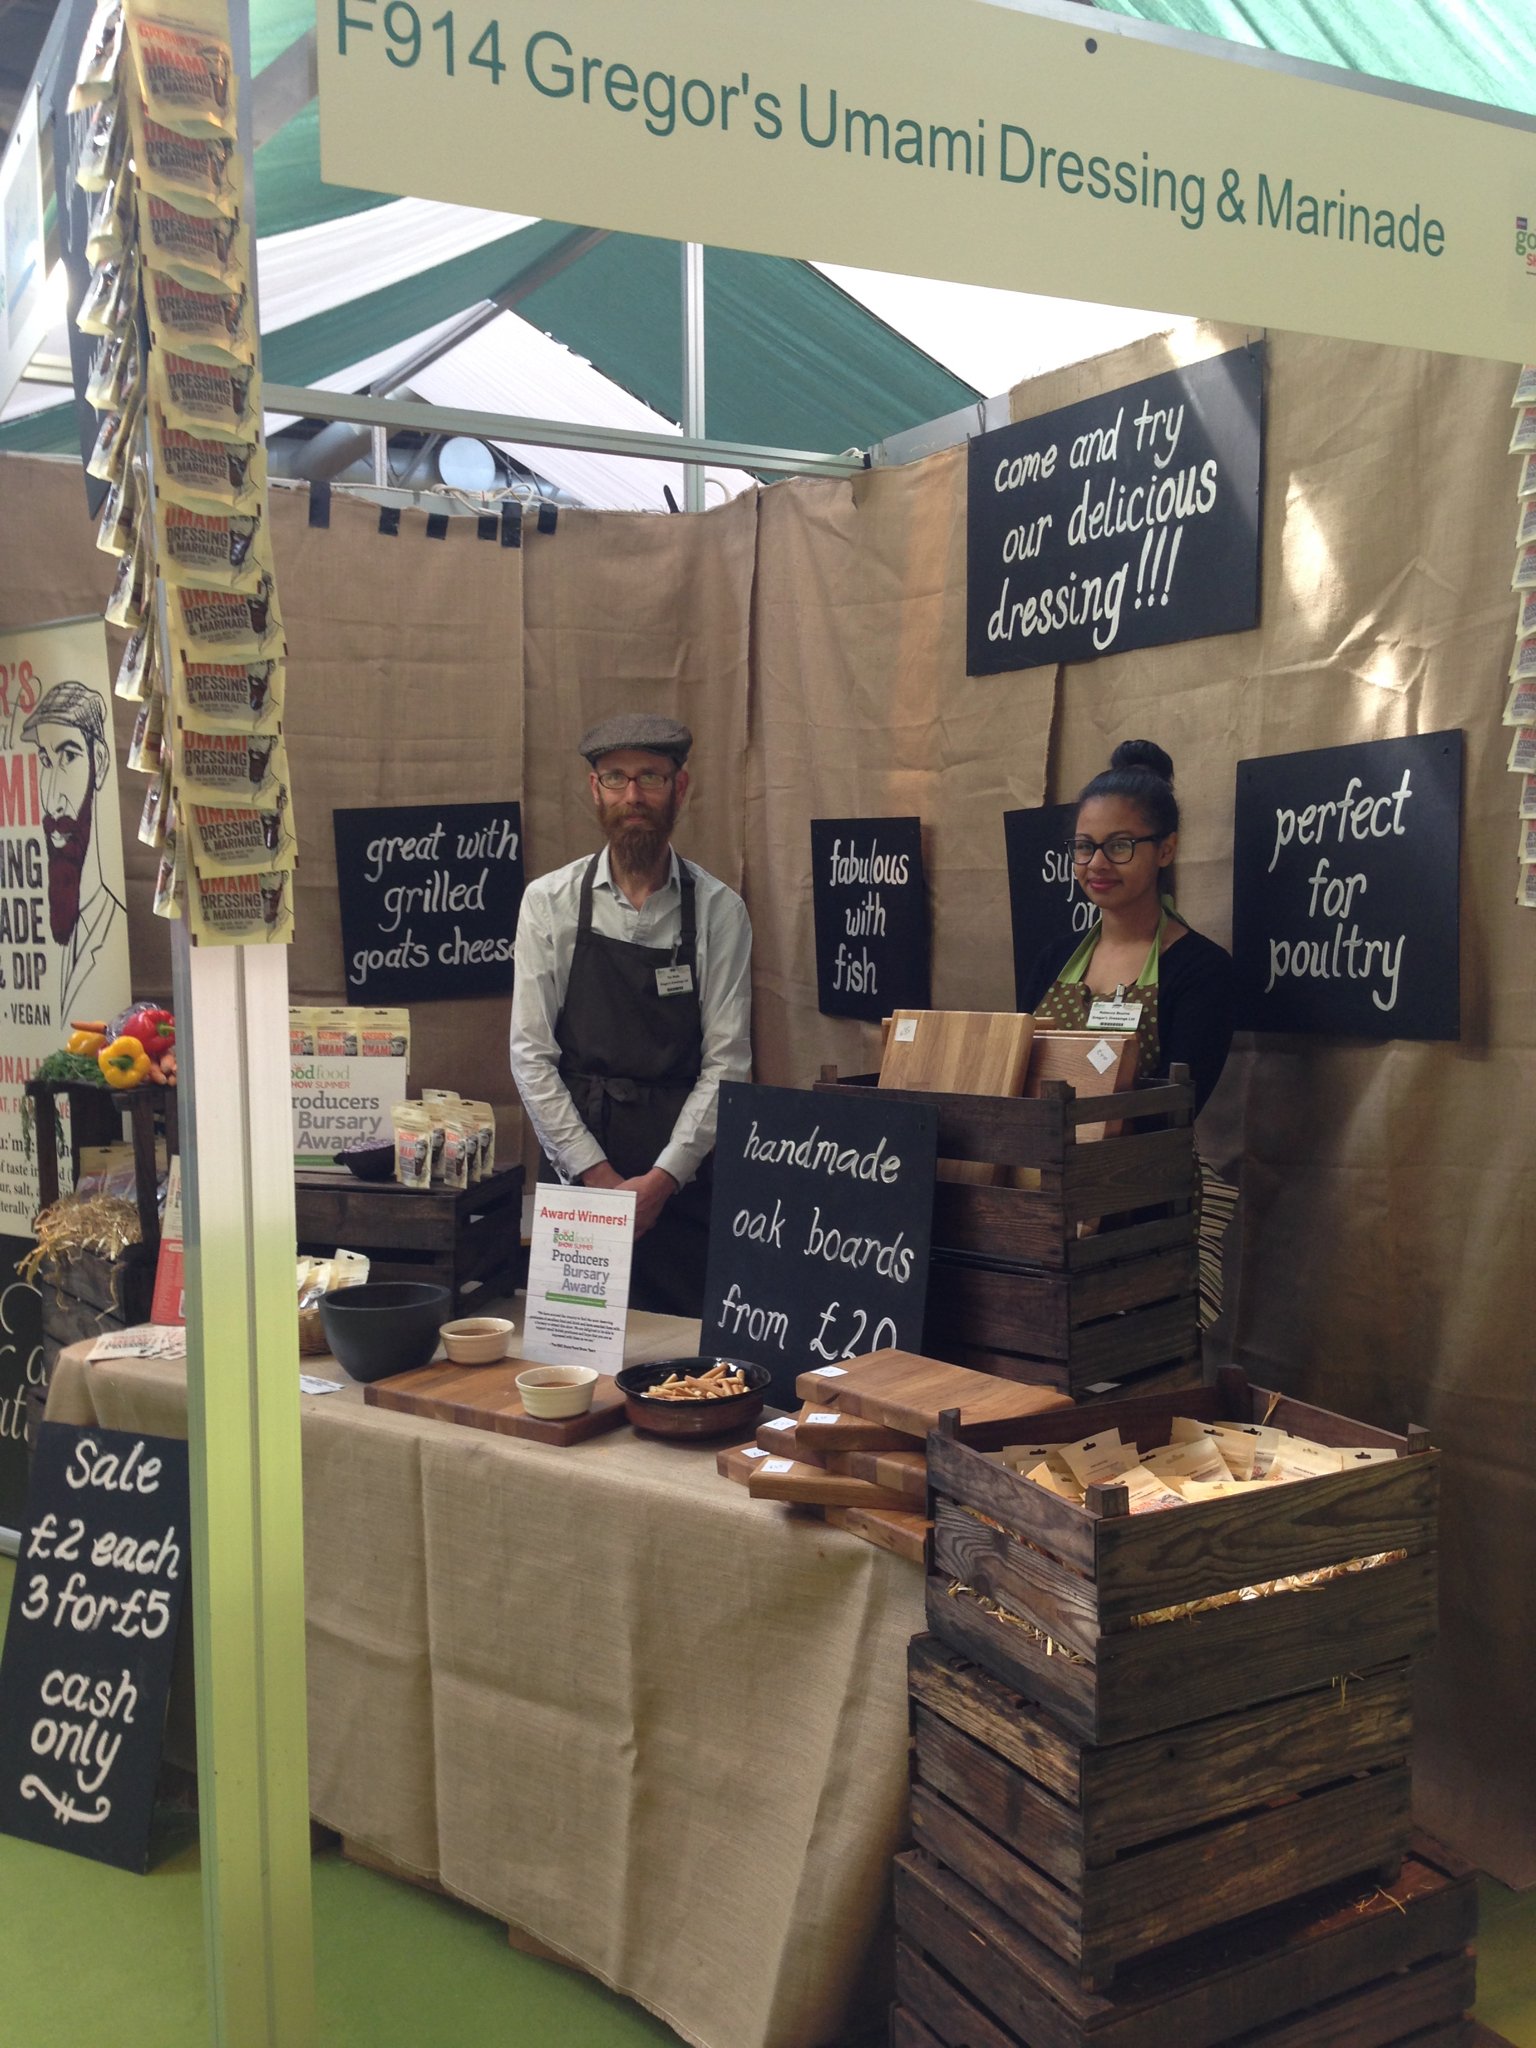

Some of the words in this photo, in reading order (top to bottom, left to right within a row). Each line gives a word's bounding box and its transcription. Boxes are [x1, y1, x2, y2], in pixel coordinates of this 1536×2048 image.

[337, 0, 506, 85] F914
[524, 31, 783, 139] Gregor's
[800, 83, 985, 177] Umami
[1000, 124, 1205, 230] Dressing
[1216, 169, 1247, 225] &
[1257, 174, 1446, 257] Marinade
[994, 444, 1057, 492] come
[1069, 407, 1124, 469] and
[1134, 399, 1184, 469] try
[1002, 513, 1052, 563] our
[1068, 459, 1217, 546] delicious
[184, 603, 248, 623] DRESSING
[186, 675, 248, 692] DRESSING
[183, 730, 247, 752] UMAMI
[184, 749, 247, 766] DRESSING
[196, 764, 248, 777] MARINADE
[199, 820, 262, 841] DRESSING
[214, 835, 264, 851] MARINADE
[1268, 769, 1412, 873] perfect
[364, 822, 446, 883] great
[456, 818, 518, 861] with
[829, 838, 910, 887] fabulous
[200, 874, 259, 895] UMAMI
[200, 893, 262, 910] DRESSING
[378, 867, 489, 933] grilled
[1308, 857, 1367, 919] for
[212, 909, 262, 920] MARINADE
[845, 891, 886, 937] with
[12, 952, 47, 990] DIP
[349, 928, 430, 985] goats
[833, 943, 878, 995] fish
[1264, 922, 1406, 1012] poultry
[11, 1003, 50, 1026] VEGAN
[298, 1111, 382, 1135] Bursary
[6, 1162, 28, 1177] taste
[743, 1120, 901, 1184] handmade
[540, 1206, 576, 1221] Award
[578, 1210, 627, 1226] Winners!
[552, 1249, 609, 1267] Producers
[733, 1198, 786, 1249] oak
[803, 1206, 915, 1283] boards
[561, 1278, 606, 1296] Awards
[563, 1264, 610, 1284] Bursary
[718, 1283, 789, 1350] from
[66, 1438, 162, 1494] Sale
[27, 1514, 85, 1562] £2
[92, 1526, 179, 1579] each
[21, 1574, 49, 1620] 3
[54, 1571, 114, 1631] for
[112, 1588, 171, 1640] £5
[40, 1668, 139, 1724] cash
[30, 1718, 122, 1794] only
